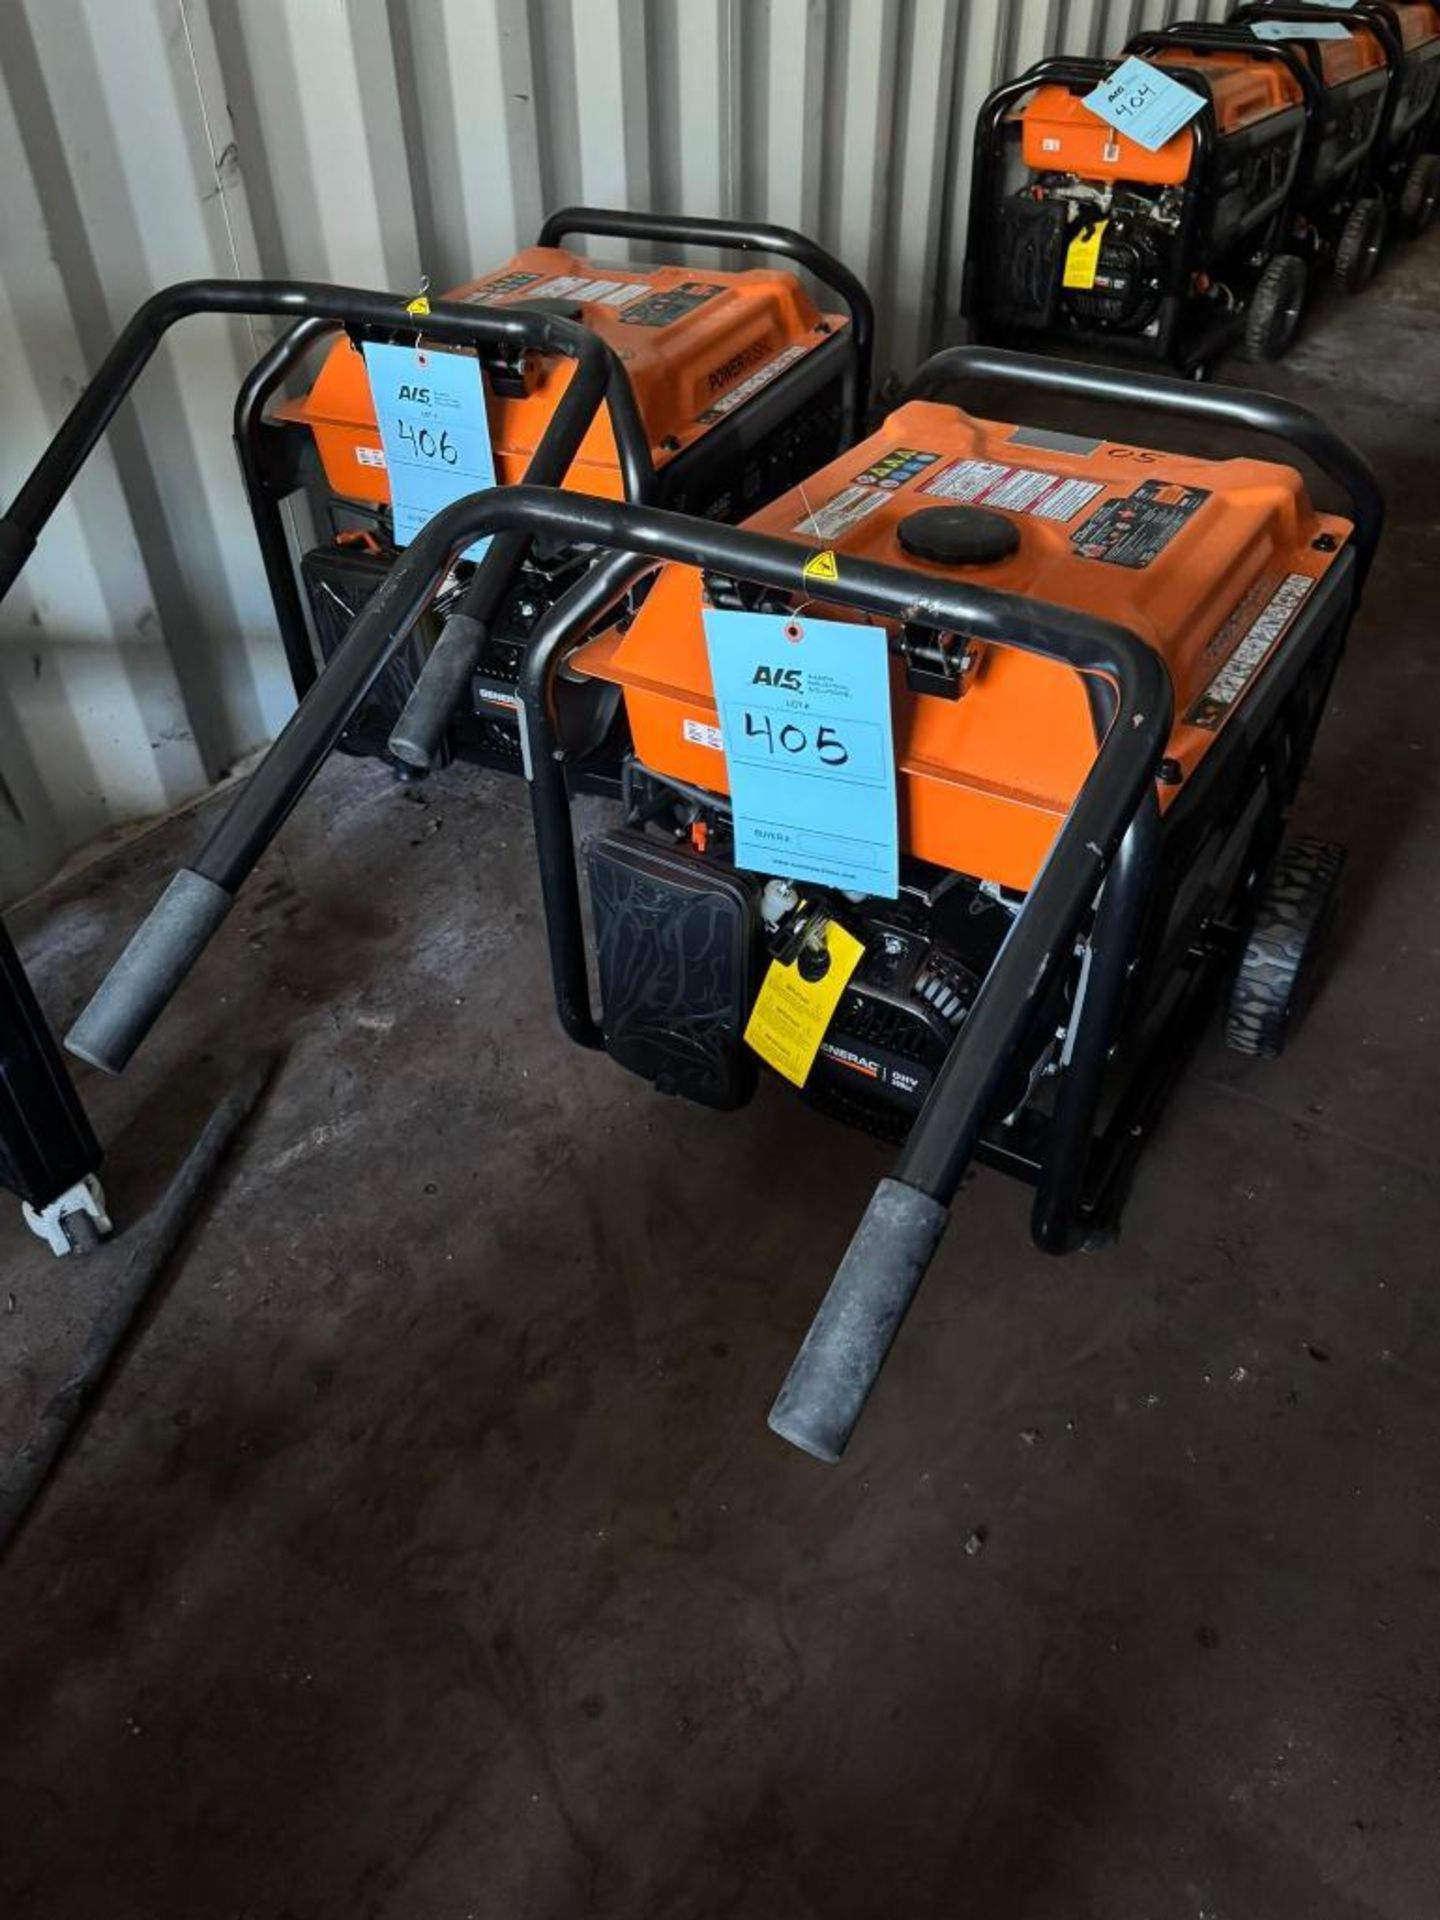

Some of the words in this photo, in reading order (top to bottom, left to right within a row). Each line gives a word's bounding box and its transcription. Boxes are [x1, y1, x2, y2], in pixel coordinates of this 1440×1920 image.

[1115, 83, 1156, 117] 404
[398, 419, 459, 465] 406
[744, 713, 850, 767] 405
